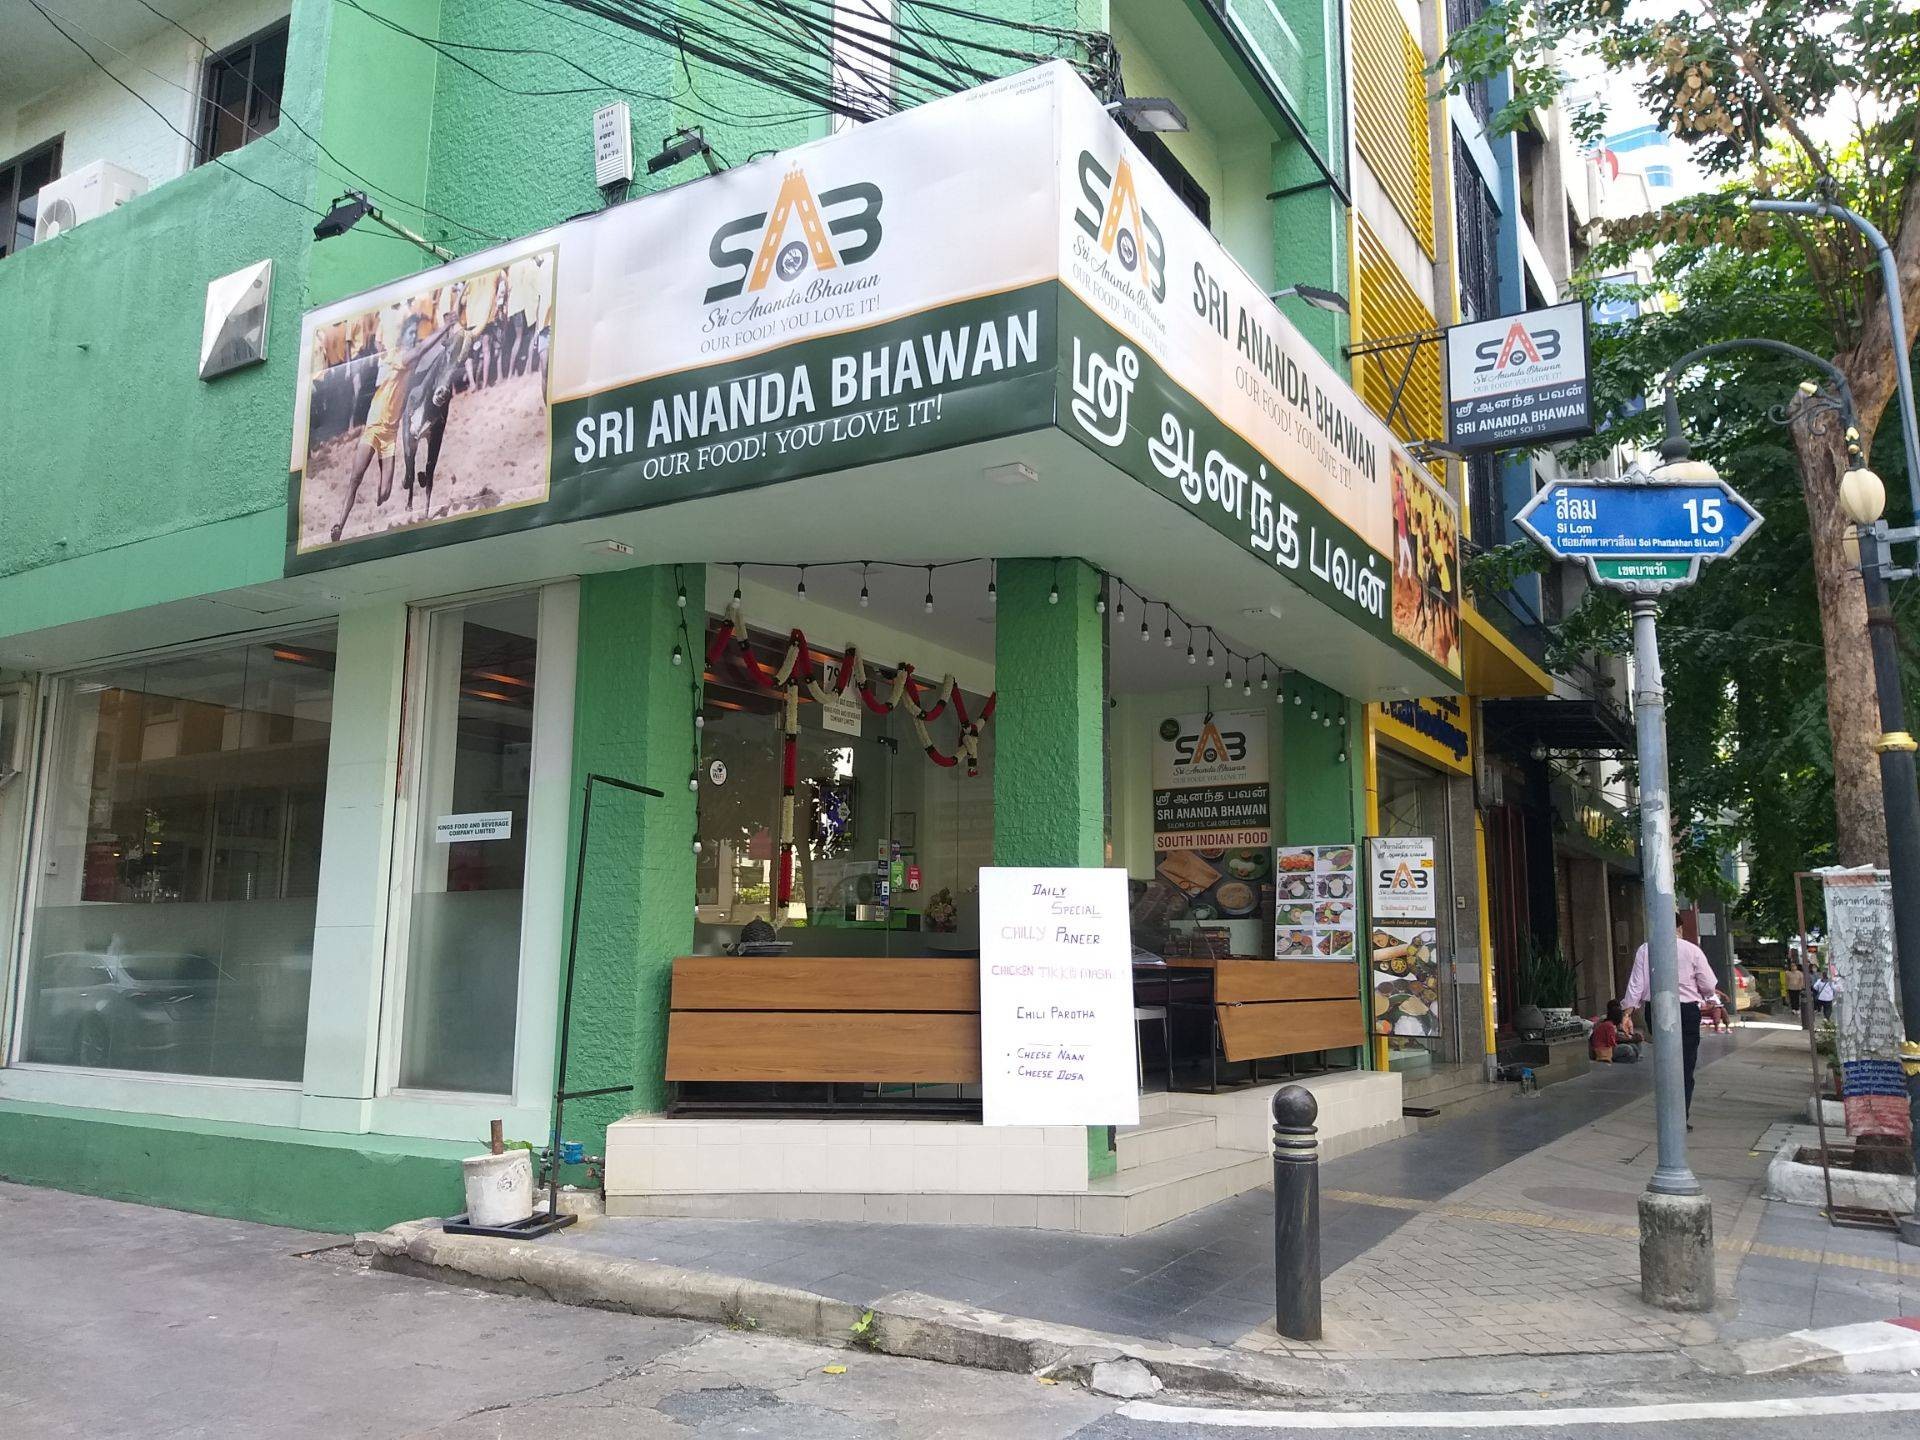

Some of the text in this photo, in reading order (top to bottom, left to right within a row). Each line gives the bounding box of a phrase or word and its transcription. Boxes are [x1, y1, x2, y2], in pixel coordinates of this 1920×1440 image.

[702, 272, 880, 335] Sri Ananda Bhawan
[700, 294, 881, 354] OUR FOOD! YOU LOVE IT!
[1193, 261, 1376, 484] SRI ANANDA BHAWAN
[574, 309, 1039, 464] SRI ANANDA BHAWAN
[1539, 384, 1583, 401] பவன்
[1236, 366, 1260, 404] OUR
[1263, 389, 1292, 437] FOOD!
[1295, 421, 1316, 455] YOU
[1457, 403, 1585, 435] SRI ANANDA BHAWAN
[643, 393, 942, 481] OUR FOOD! YOU LOVE IT!
[1494, 429, 1517, 439] SILOM
[1520, 426, 1533, 435] SOI
[1555, 489, 1597, 520] สีลม
[1148, 412, 1301, 570] ஆனந்த
[1310, 526, 1386, 620] பவன்
[1683, 498, 1724, 534] 15
[1557, 523, 1592, 533] Si Lom
[1639, 538, 1651, 547] Soi
[1653, 538, 1693, 547] Phattakhan
[1157, 803, 1266, 820] SRI ANANDA BHAWAN
[1157, 832, 1268, 848] SOUTH INDIAN FOOD
[1032, 884, 1067, 896] DAILY
[1051, 902, 1101, 915] SPECIAL
[1001, 926, 1100, 945] CHILLY PANEER
[1016, 1006, 1096, 1019] CHILI PAROTHA
[1017, 1048, 1085, 1062] CHEESE NAAN
[1018, 1065, 1084, 1081] CHEESE DOSA
